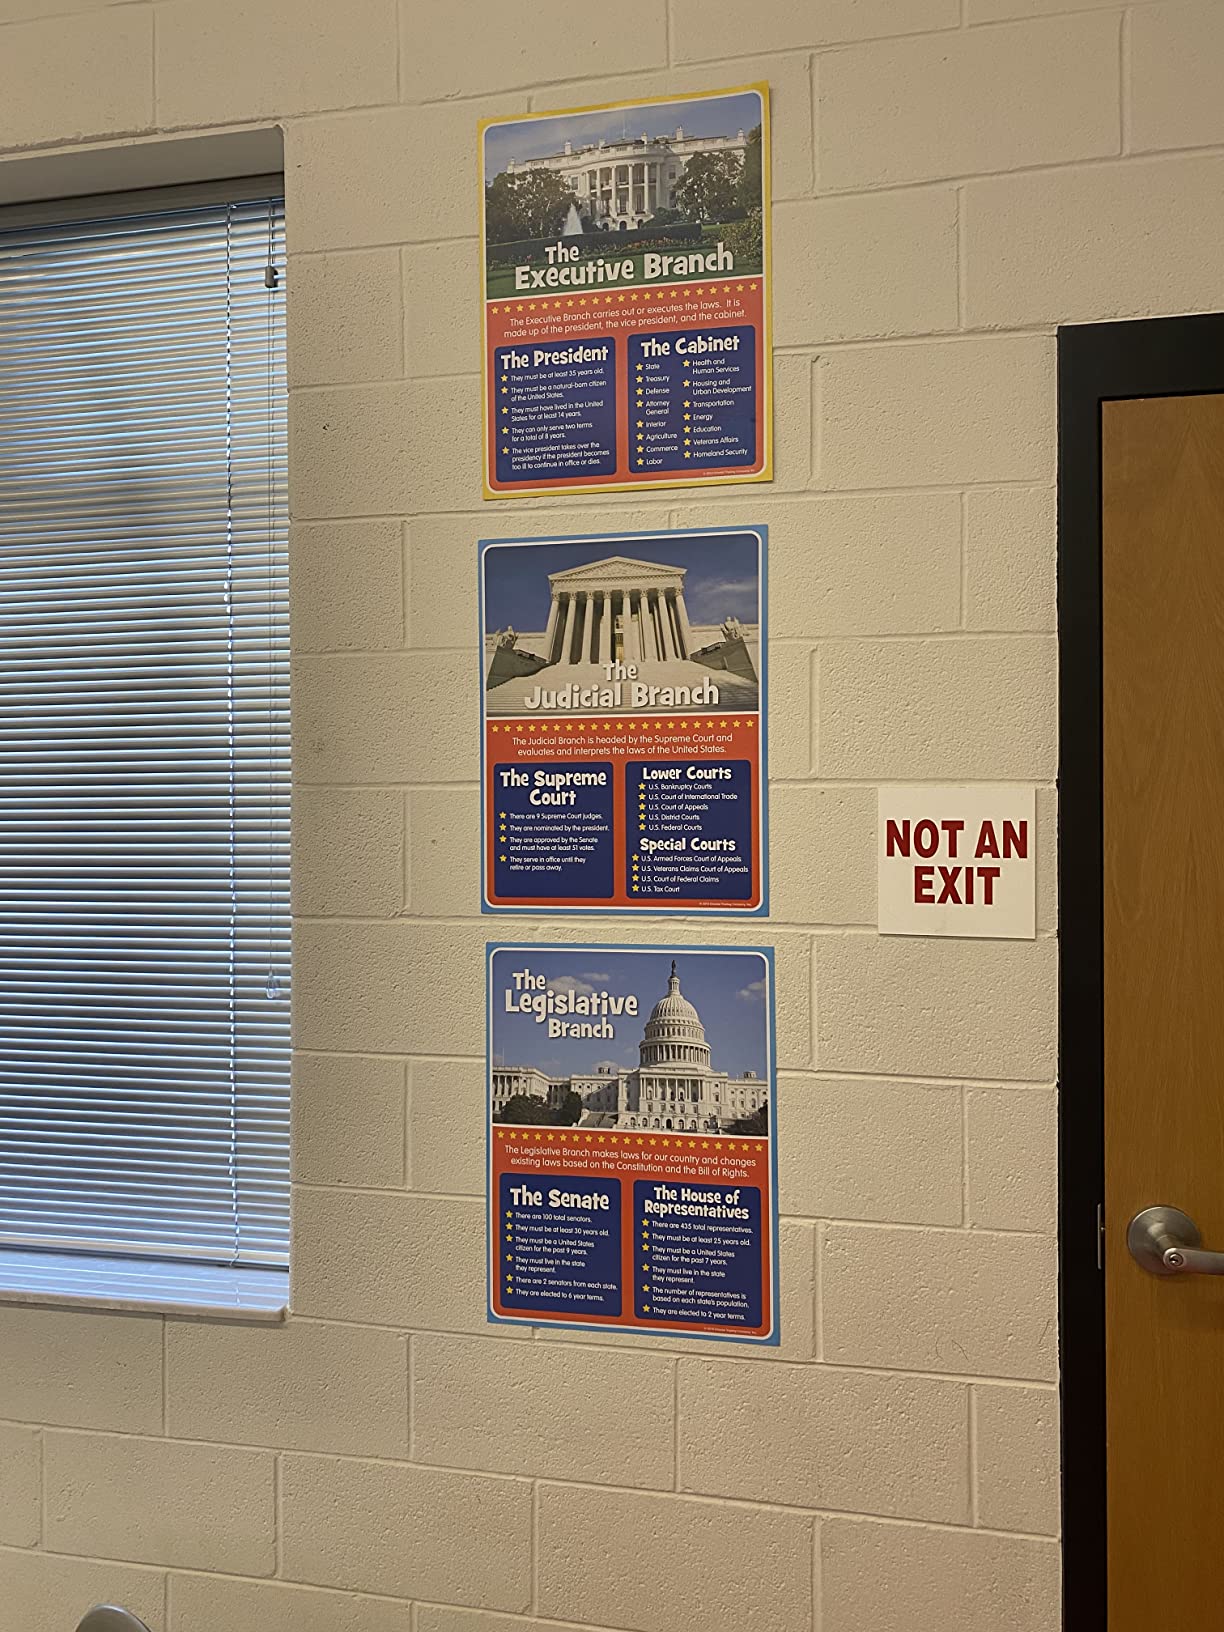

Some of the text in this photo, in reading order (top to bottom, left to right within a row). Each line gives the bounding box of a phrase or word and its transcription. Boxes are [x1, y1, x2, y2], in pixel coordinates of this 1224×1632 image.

[544, 241, 579, 265] The
[515, 242, 734, 290] Executive Branch
[510, 317, 524, 326] The
[525, 314, 562, 324] Executive
[563, 311, 591, 321] Branch
[591, 309, 620, 319] carries
[621, 307, 635, 316] out
[647, 303, 683, 314] executes
[685, 302, 698, 311] the
[700, 300, 722, 310] laws.
[726, 299, 733, 307] It
[733, 298, 740, 307] is
[504, 310, 747, 338] made up of the president, the vice president, and the cabinet.
[640, 335, 740, 357] The Cabinet
[501, 346, 609, 370] The President
[645, 375, 670, 383] Treasury
[693, 367, 714, 375] Human
[693, 380, 718, 388] Housing
[713, 386, 752, 394] Development
[645, 400, 670, 408] Attorney
[693, 400, 734, 408] Transportation
[646, 432, 677, 441] Agriculture
[693, 425, 722, 433] Education
[693, 449, 748, 458] Homeland Security
[602, 659, 637, 681] The
[524, 676, 719, 710] Judicial Branch
[512, 734, 733, 746] The Judicial Branch is headed by the Supreme Court and
[518, 745, 727, 757] evaluates and interprets the laws of the United States.
[500, 768, 607, 791] The Supreme
[643, 766, 732, 780] Lower Courts
[529, 789, 576, 806] Court
[640, 837, 736, 854] Special Courts
[886, 819, 1028, 859] NOT AN
[914, 866, 1001, 905] EXIT
[512, 968, 546, 990] The
[505, 989, 638, 1023] Legislative
[548, 1016, 614, 1039] Branch
[505, 1145, 519, 1155] The
[520, 1146, 561, 1159] Legislative
[562, 1148, 590, 1158] Branch
[592, 1150, 619, 1159] makes
[620, 1151, 639, 1160] laws
[641, 1152, 652, 1161] for
[669, 1153, 700, 1165] country
[702, 1155, 718, 1164] and
[720, 1156, 756, 1168] changes
[511, 1156, 541, 1168] existing
[542, 1158, 561, 1167] laws
[562, 1159, 588, 1168] based
[601, 1161, 615, 1170] the
[616, 1162, 663, 1172] Constitution
[665, 1164, 681, 1173] and
[683, 1165, 696, 1174] the
[698, 1166, 710, 1175] Bill
[712, 1166, 721, 1175] of
[722, 1167, 750, 1179] Rights.
[510, 1184, 609, 1210] The Senate
[653, 1185, 740, 1205] The House of
[644, 1199, 750, 1220] Representatives
